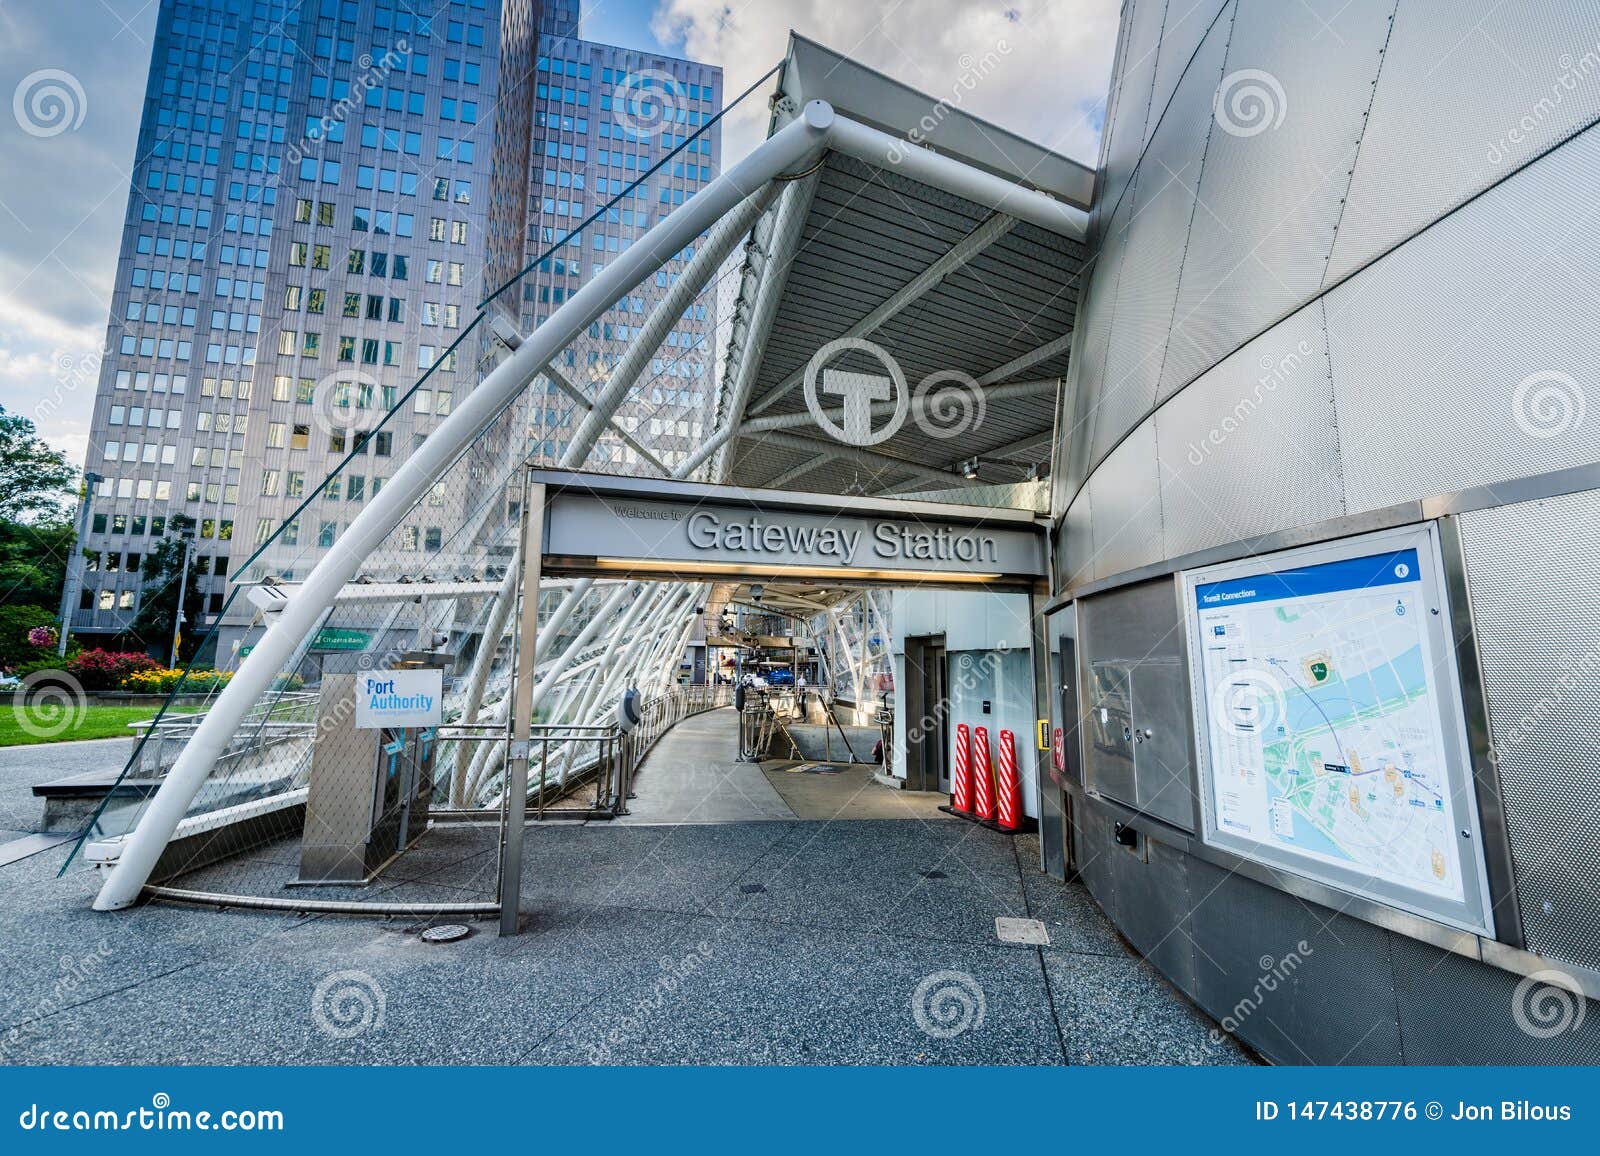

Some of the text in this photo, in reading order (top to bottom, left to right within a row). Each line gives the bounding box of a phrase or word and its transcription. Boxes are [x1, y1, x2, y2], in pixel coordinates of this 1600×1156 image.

[613, 503, 683, 521] Welcome to
[686, 511, 1002, 565] Gateway Station
[1203, 589, 1256, 603] Transit Connections
[322, 636, 348, 645] Citizens
[367, 678, 395, 695] Port
[369, 693, 433, 712] Authority
